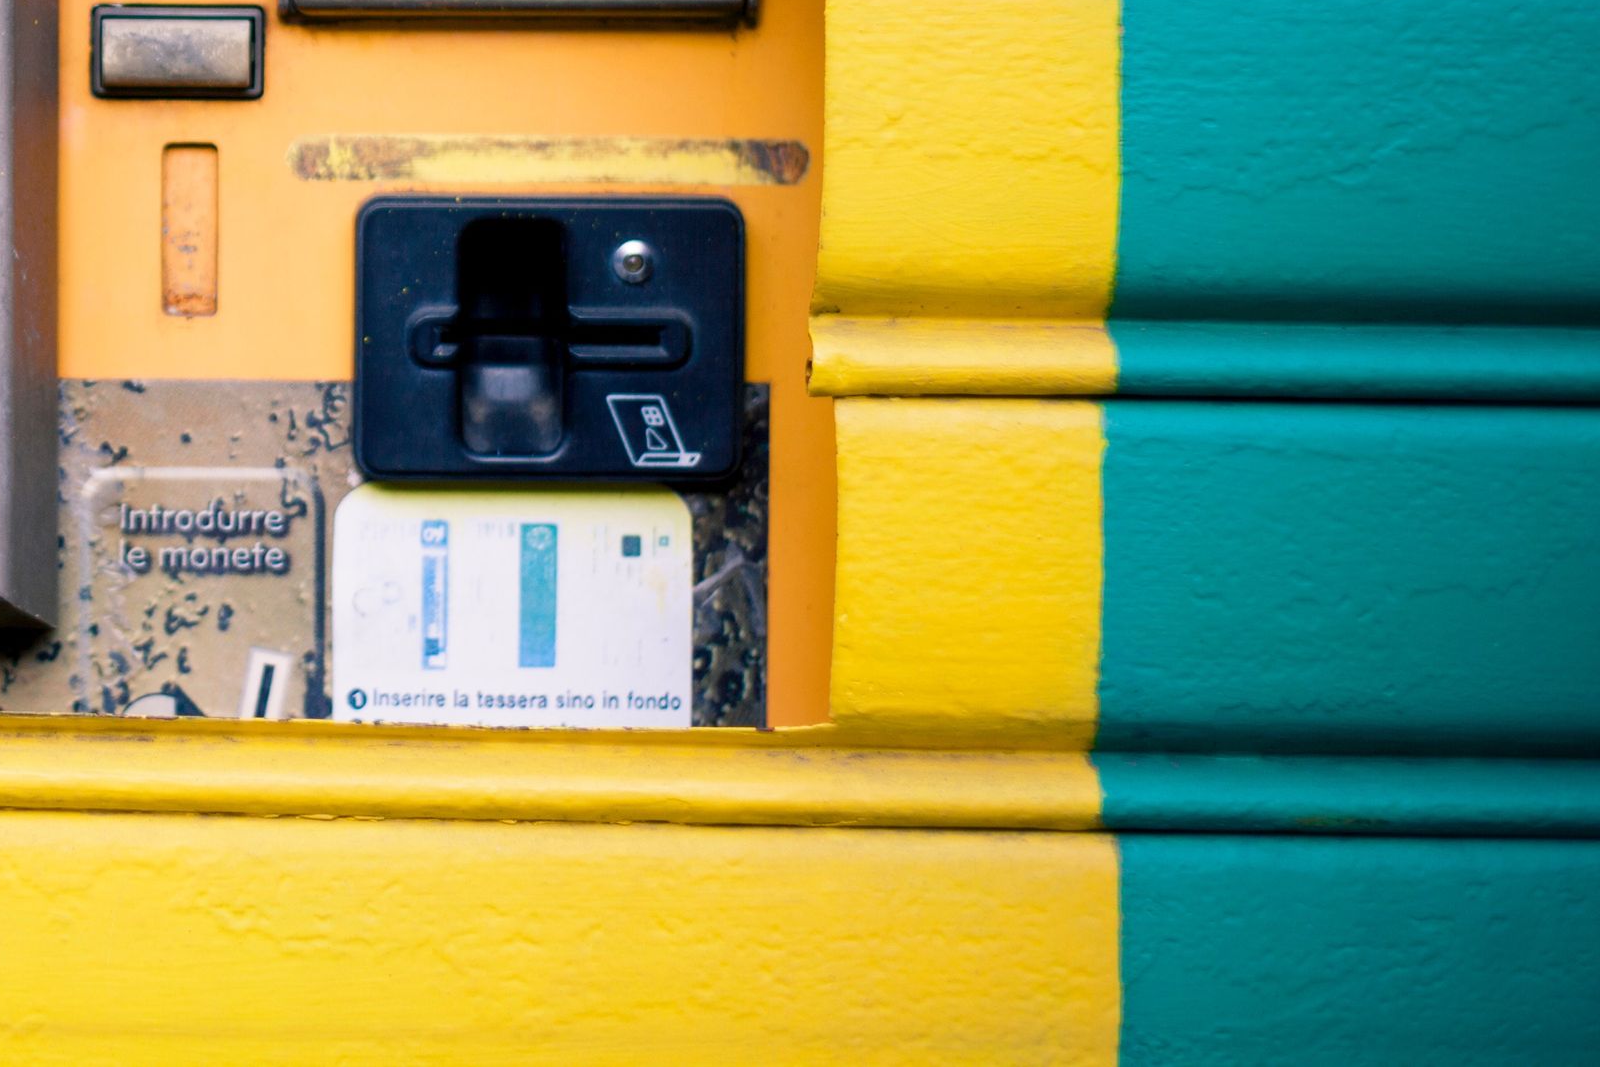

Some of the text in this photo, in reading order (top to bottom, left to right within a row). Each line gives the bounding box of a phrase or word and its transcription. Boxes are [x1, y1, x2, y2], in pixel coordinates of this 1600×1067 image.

[120, 499, 285, 533] Introdurre
[120, 539, 286, 569] le monete
[373, 689, 446, 707] Inserire
[454, 690, 469, 708] la
[477, 691, 548, 709] tessera
[556, 692, 594, 709] sino
[603, 691, 619, 709] in
[627, 691, 681, 710] fondo
